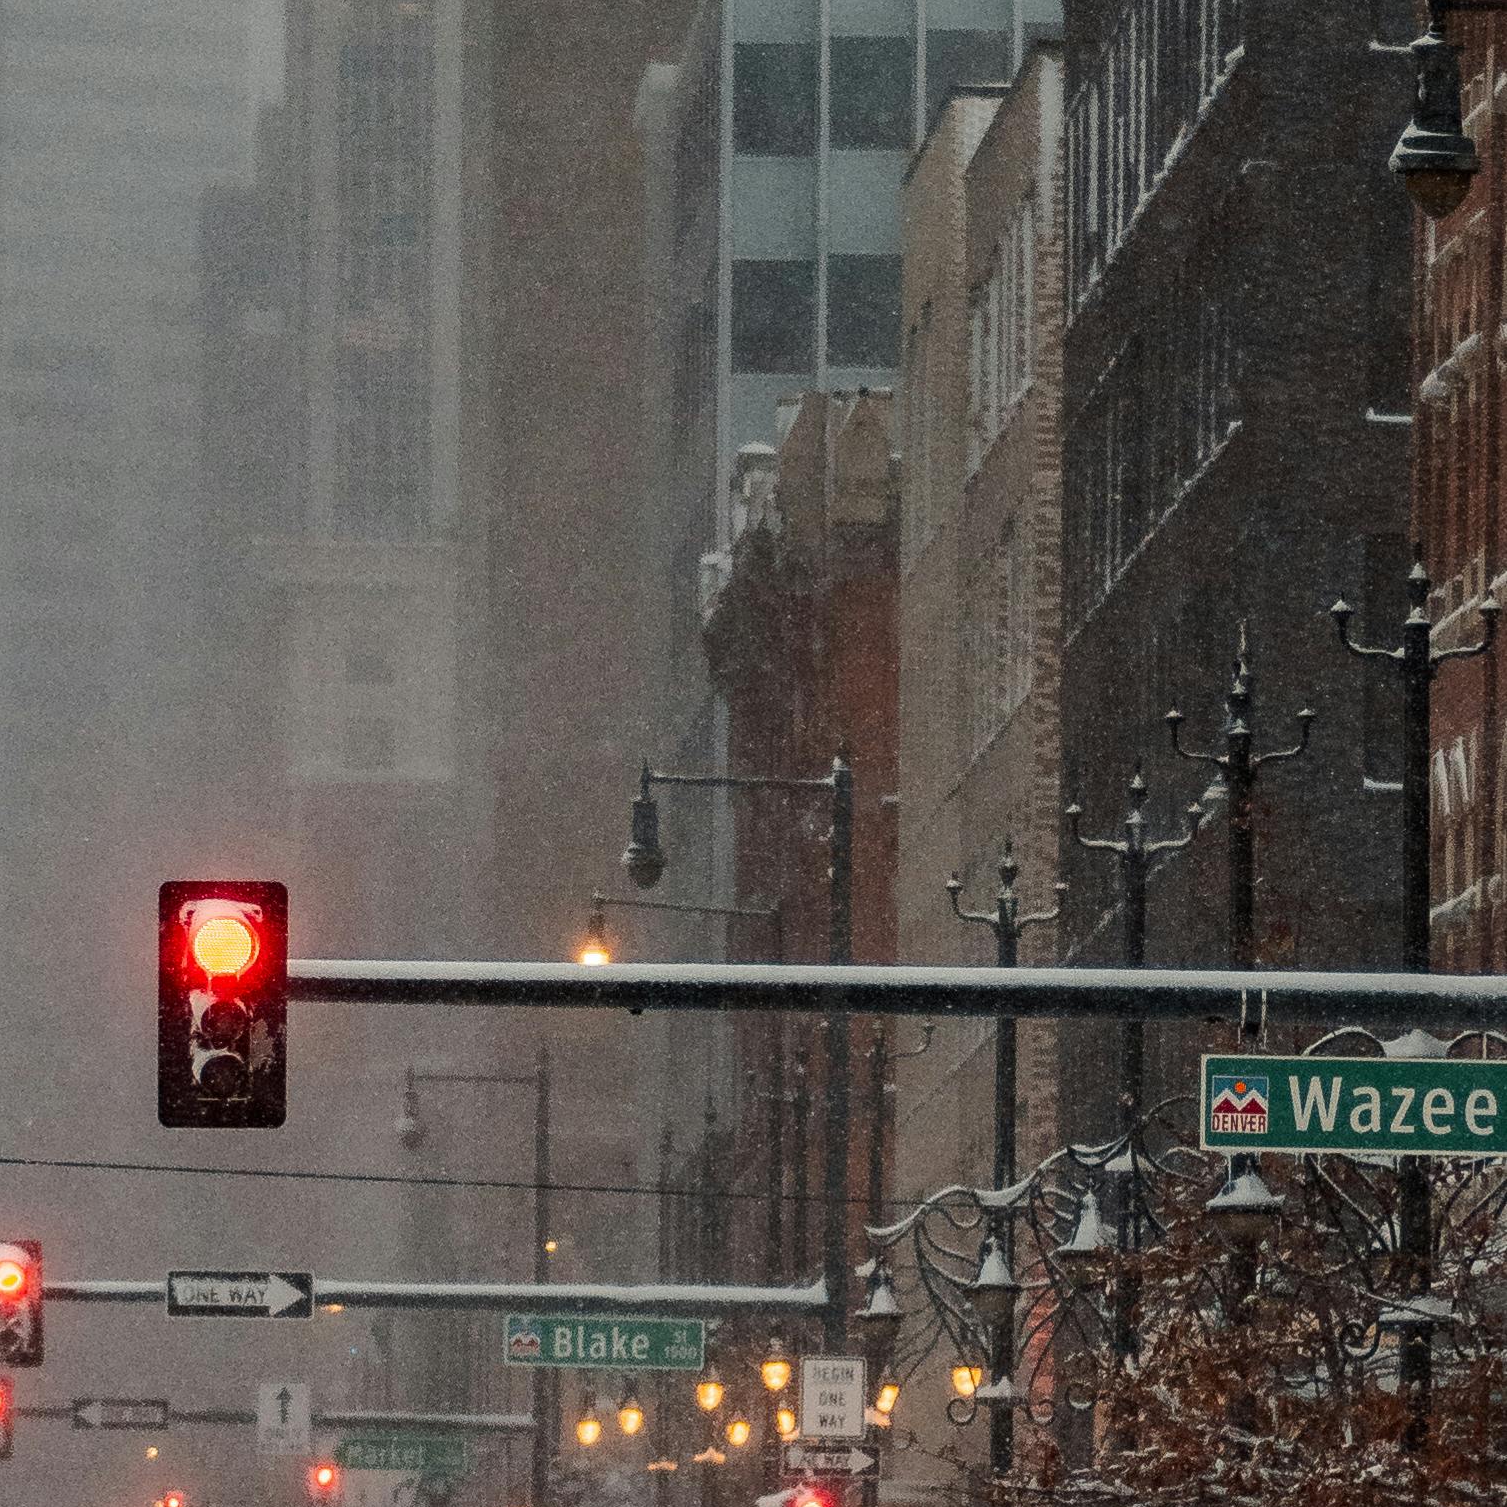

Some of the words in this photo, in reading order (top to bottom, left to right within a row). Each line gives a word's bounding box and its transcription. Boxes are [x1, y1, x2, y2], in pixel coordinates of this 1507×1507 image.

[1288, 1075, 1498, 1136] Wazee
[1211, 1113, 1267, 1133] DENVER
[229, 1285, 268, 1304] WAY
[553, 1325, 651, 1360] Blake
[812, 1365, 855, 1382] BEGIN
[818, 1391, 846, 1407] ONE
[818, 1414, 846, 1429] WAY
